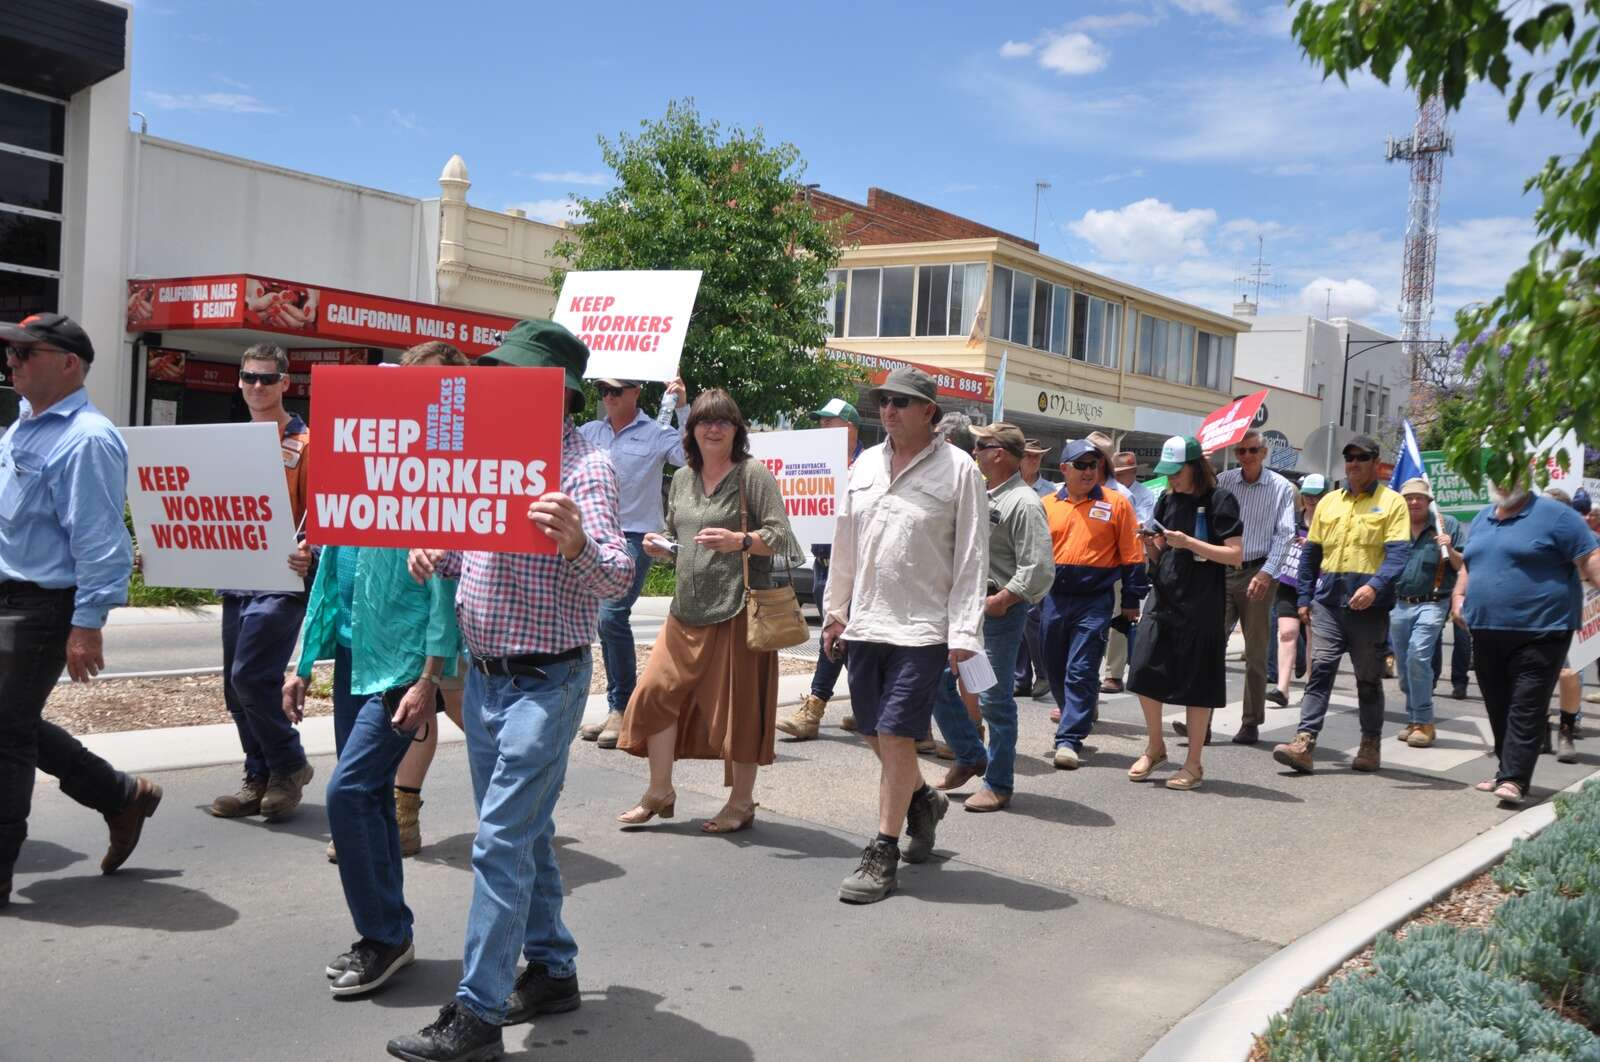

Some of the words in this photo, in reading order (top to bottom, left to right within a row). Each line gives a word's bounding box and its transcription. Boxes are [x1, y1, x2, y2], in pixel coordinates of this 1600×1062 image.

[159, 284, 208, 302] CALIFORNIA
[211, 282, 238, 301] NAILS
[569, 296, 615, 312] KEEP
[193, 303, 200, 318] &
[202, 301, 236, 318] BEAUTY
[327, 303, 411, 333] CALIFORNIA
[416, 317, 455, 340] NAILS
[460, 324, 468, 342] &
[581, 315, 673, 334] WORKERS
[578, 333, 661, 352] ORKING!
[453, 376, 466, 412] JOBS
[933, 374, 955, 389] 881
[959, 378, 983, 394] 8885
[425, 403, 439, 451] WATER
[438, 378, 453, 451] BUYBACKS
[333, 418, 420, 453] KEEP
[452, 413, 465, 451] HURT
[137, 466, 190, 491] KEEP
[363, 456, 547, 497] WORKERS
[760, 459, 783, 476] EP
[776, 477, 835, 496] LIQUIN
[1432, 487, 1488, 502] ARMING
[162, 495, 273, 522] WORKERS
[314, 494, 508, 534] WORKING!
[785, 497, 835, 516] IVING!
[150, 524, 269, 551] WORKING!
